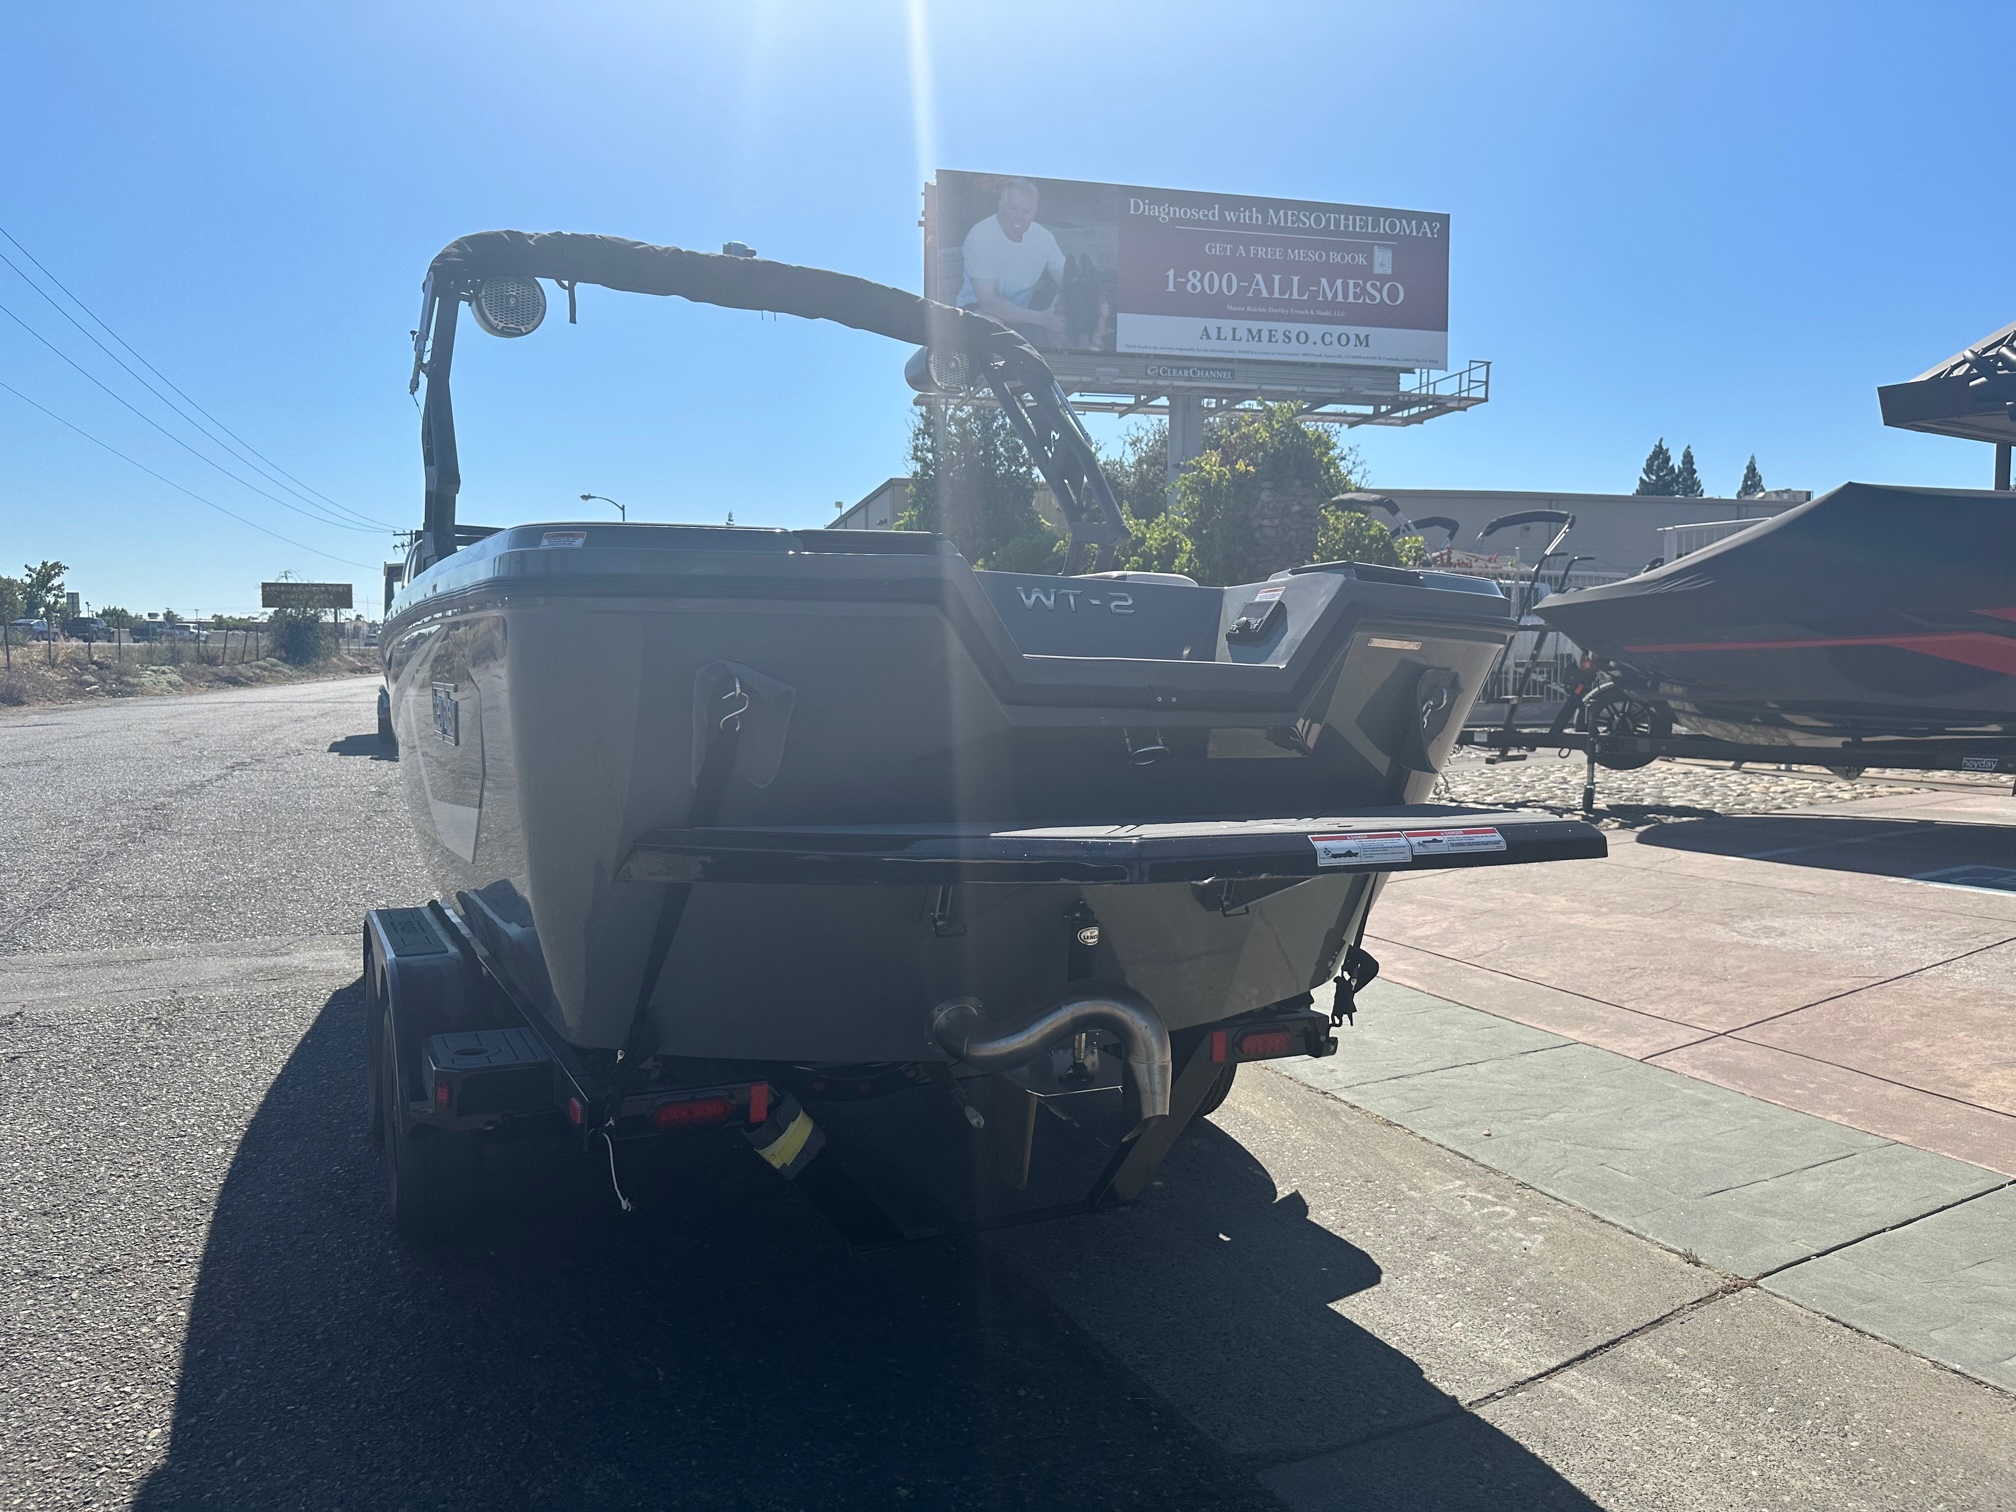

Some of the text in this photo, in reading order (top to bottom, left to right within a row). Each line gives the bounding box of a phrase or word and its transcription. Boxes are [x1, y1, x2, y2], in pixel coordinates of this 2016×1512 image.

[1129, 198, 1441, 238] Diagnosed with MESOTHELIOMA?
[1205, 243, 1233, 257] GET
[1236, 245, 1246, 257] A
[1250, 246, 1284, 260] FREE
[1286, 248, 1326, 263] MESO
[1329, 252, 1368, 266] BOOK
[1164, 268, 1405, 307] 1-800-ALL-MESO
[1199, 325, 1371, 348] ALLMESO.COM
[1016, 586, 1135, 615] WT-2
[1962, 757, 1999, 771] heyday
